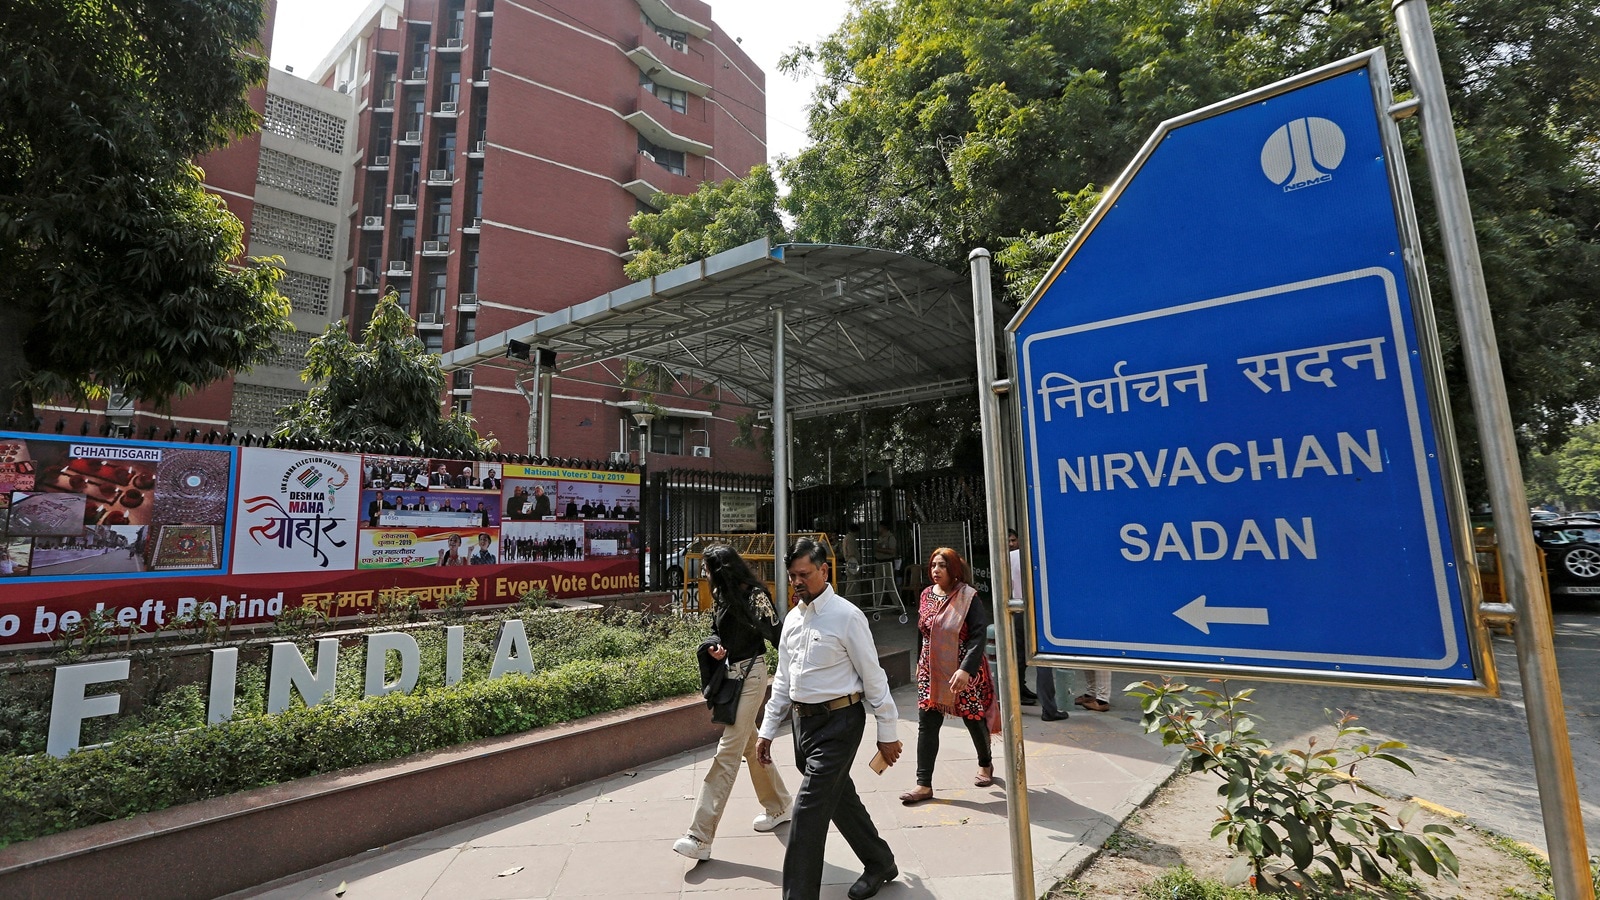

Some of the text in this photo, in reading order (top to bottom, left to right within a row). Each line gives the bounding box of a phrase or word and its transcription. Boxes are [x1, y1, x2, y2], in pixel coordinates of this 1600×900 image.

[1284, 174, 1332, 192] NDMC
[1037, 336, 1387, 422] निर्वाचन सदन
[73, 446, 159, 460] CHHATTISGARH
[295, 457, 323, 468] ELECTION
[323, 458, 338, 469] 2019
[1057, 428, 1384, 494] NIRVACHAN
[524, 467, 625, 481] National Voters' Day 2019
[288, 501, 324, 513] MAHA
[289, 491, 325, 501] DESH KA
[1119, 516, 1318, 562] SADAN
[495, 572, 640, 598] Every Vote Counts
[33, 605, 82, 635] be
[94, 599, 166, 629] Left
[177, 592, 284, 622] Behind
[206, 618, 536, 727] INDIA
[46, 658, 131, 758] F
